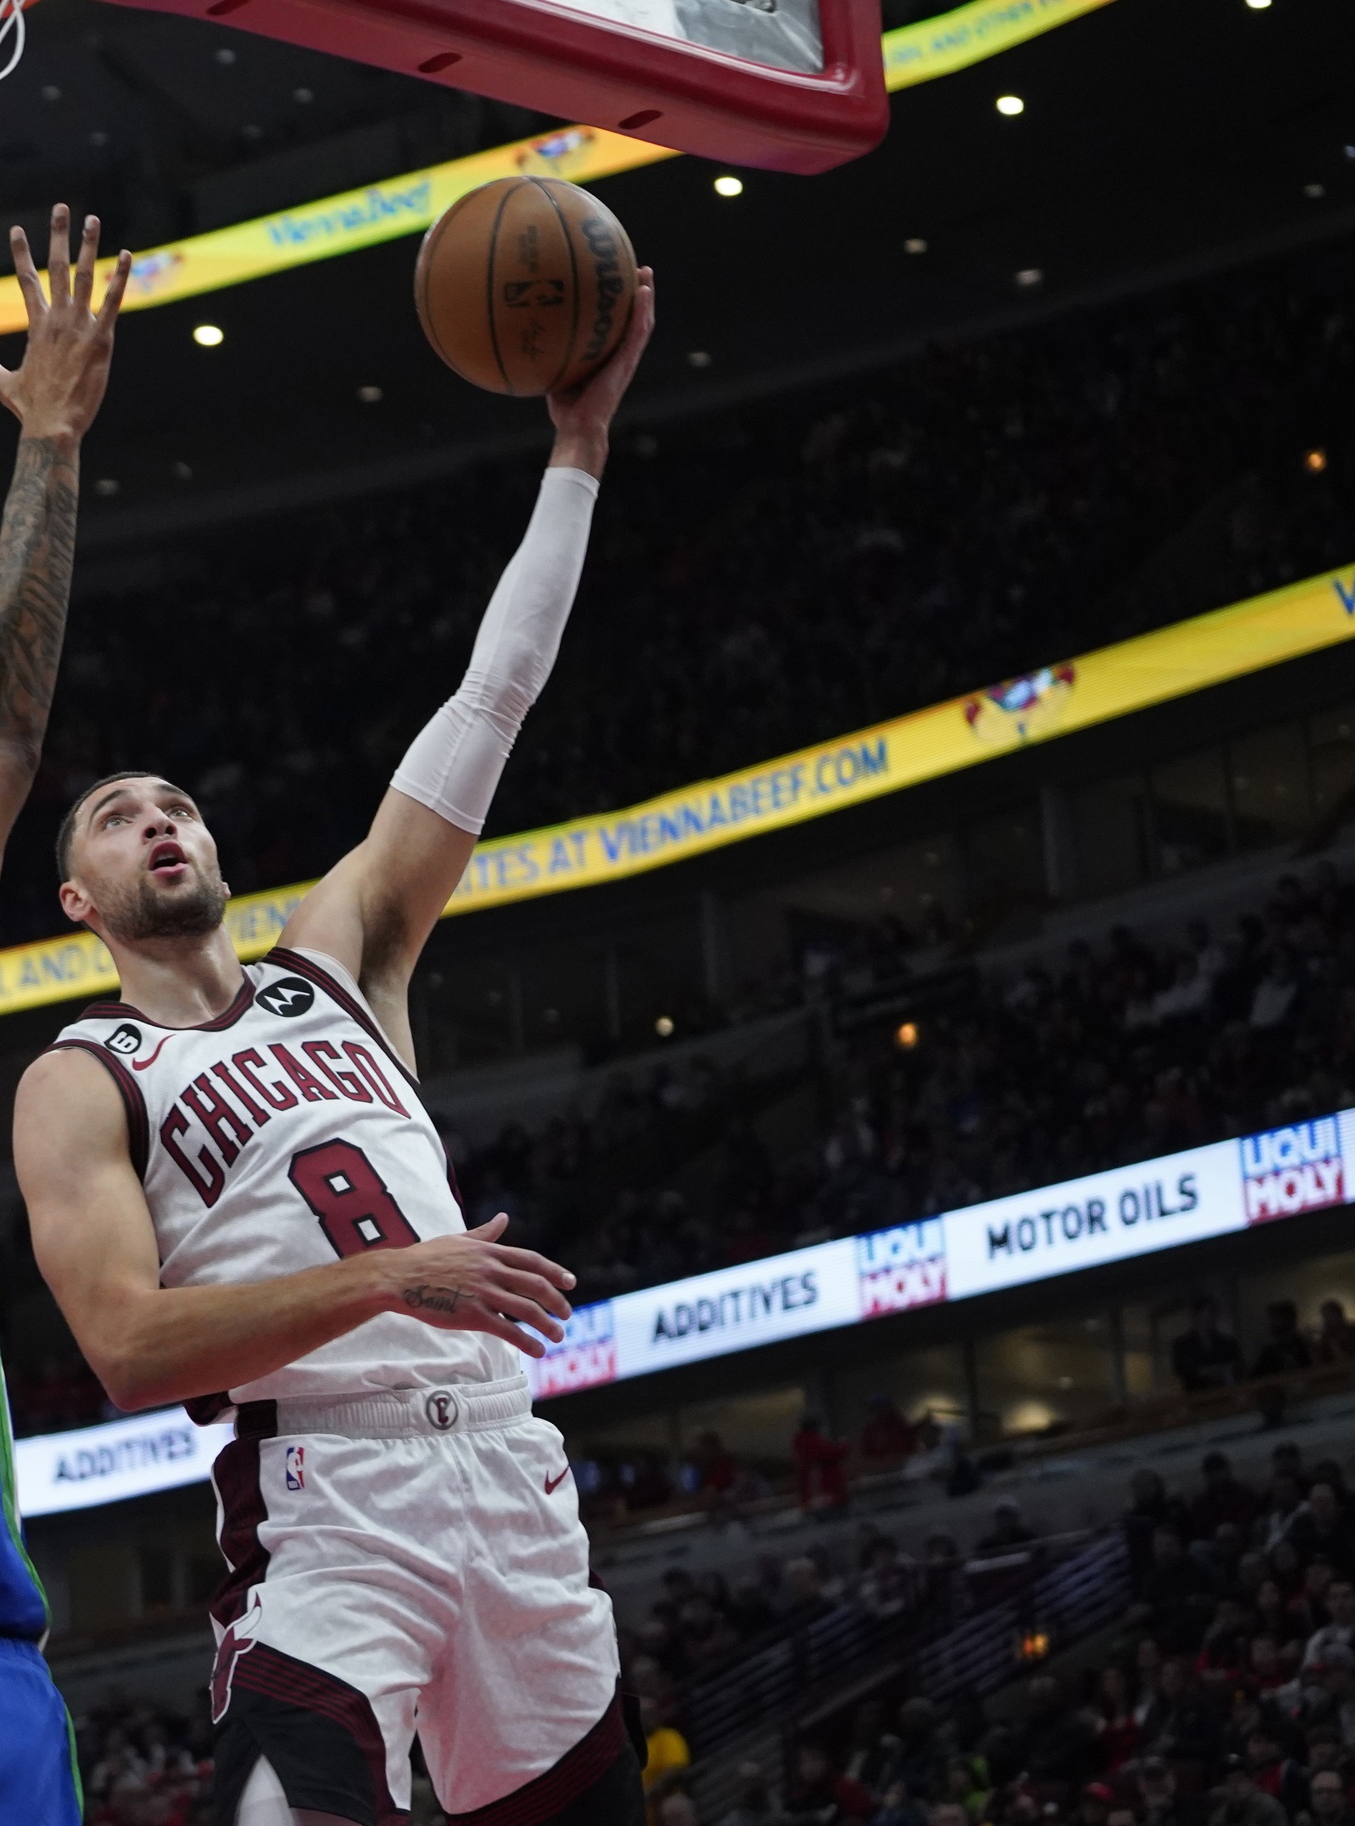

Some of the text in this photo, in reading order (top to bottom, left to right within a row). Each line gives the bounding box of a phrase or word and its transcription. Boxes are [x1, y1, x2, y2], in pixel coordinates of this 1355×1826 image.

[548, 829, 588, 875] AT
[598, 734, 889, 864] VIENNABEEF.COM
[109, 1030, 139, 1052] 6
[159, 1040, 412, 1209] CHICAGO
[287, 1137, 422, 1262] 8
[986, 1172, 1199, 1260] MOTOR OILS
[1247, 1155, 1344, 1223] MOLY
[652, 1270, 819, 1344] ADDITIVES
[859, 1257, 948, 1318] MOLY
